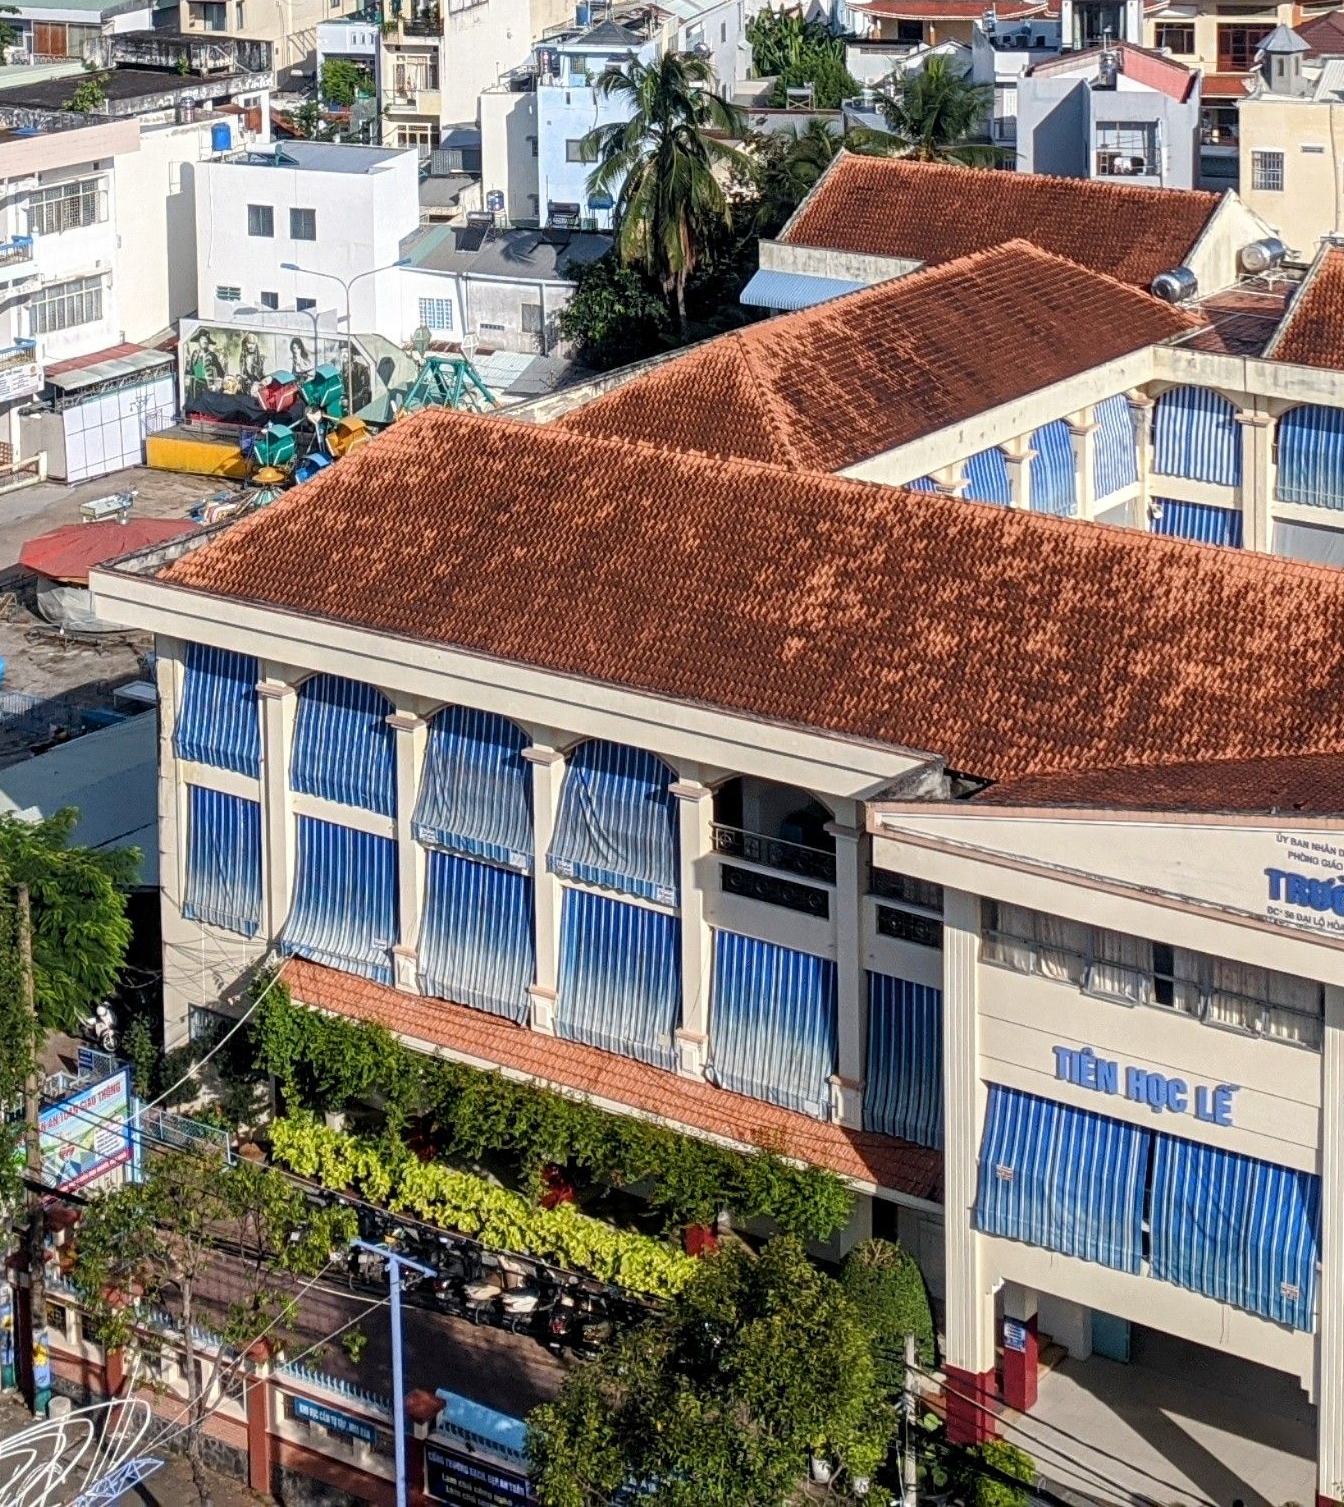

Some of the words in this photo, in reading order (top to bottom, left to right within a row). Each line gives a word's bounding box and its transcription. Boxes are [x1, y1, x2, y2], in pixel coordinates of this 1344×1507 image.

[1276, 832, 1289, 843] ỦY
[1291, 837, 1309, 850] BAN
[1311, 840, 1337, 856] NHÂN
[1288, 850, 1319, 866] PHÒNG
[1321, 858, 1344, 872] GIÁO
[1052, 1045, 1118, 1095] TIÊN
[1125, 1066, 1188, 1113] HỌC
[1193, 1083, 1241, 1127] LỄ
